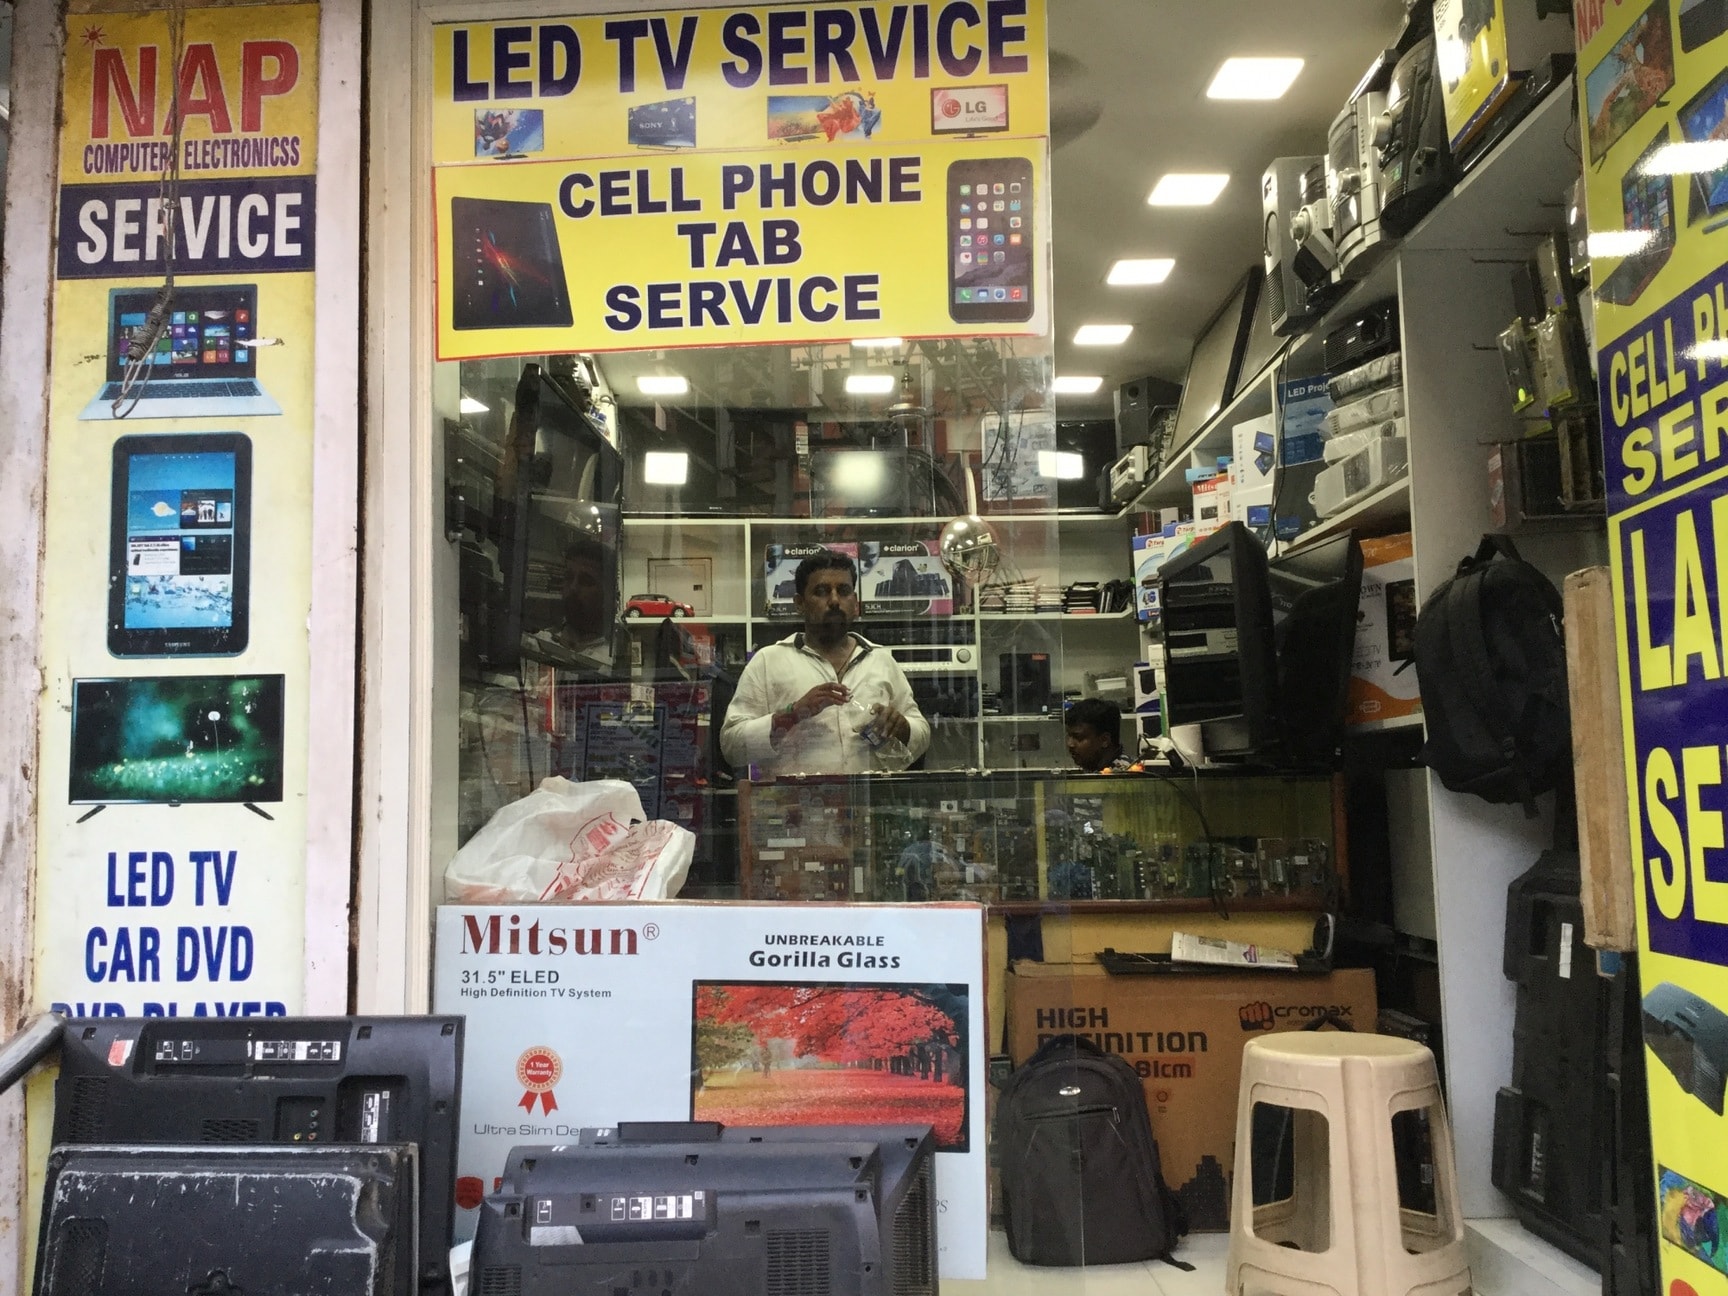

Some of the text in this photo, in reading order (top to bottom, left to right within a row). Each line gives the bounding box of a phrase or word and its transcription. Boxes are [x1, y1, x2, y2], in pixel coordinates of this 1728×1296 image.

[452, 0, 1030, 101] LED TV SERVICE
[91, 40, 300, 139] NAP
[965, 101, 988, 114] LG
[184, 136, 300, 170] ELECTRONICSS
[558, 157, 922, 219] CELL PHONE
[77, 192, 302, 264] SERVICE
[677, 219, 802, 269] TAB
[604, 274, 880, 331] SERVICE
[1610, 316, 1687, 428] CELL
[1287, 387, 1306, 398] LED
[889, 544, 919, 553] clarion
[1645, 744, 1728, 925] SE
[106, 850, 238, 907] LED TV
[85, 925, 255, 983] CAR DVD
[765, 934, 885, 947] UNBREAKABLE
[749, 950, 901, 969] Gorilla Glass
[460, 987, 612, 999] High Definition TV System
[461, 970, 560, 984] 31.5" ELED
[1036, 1007, 1109, 1029] HIGH
[526, 1069, 552, 1077] Warranty
[474, 1124, 580, 1137] Ultra Slim De
